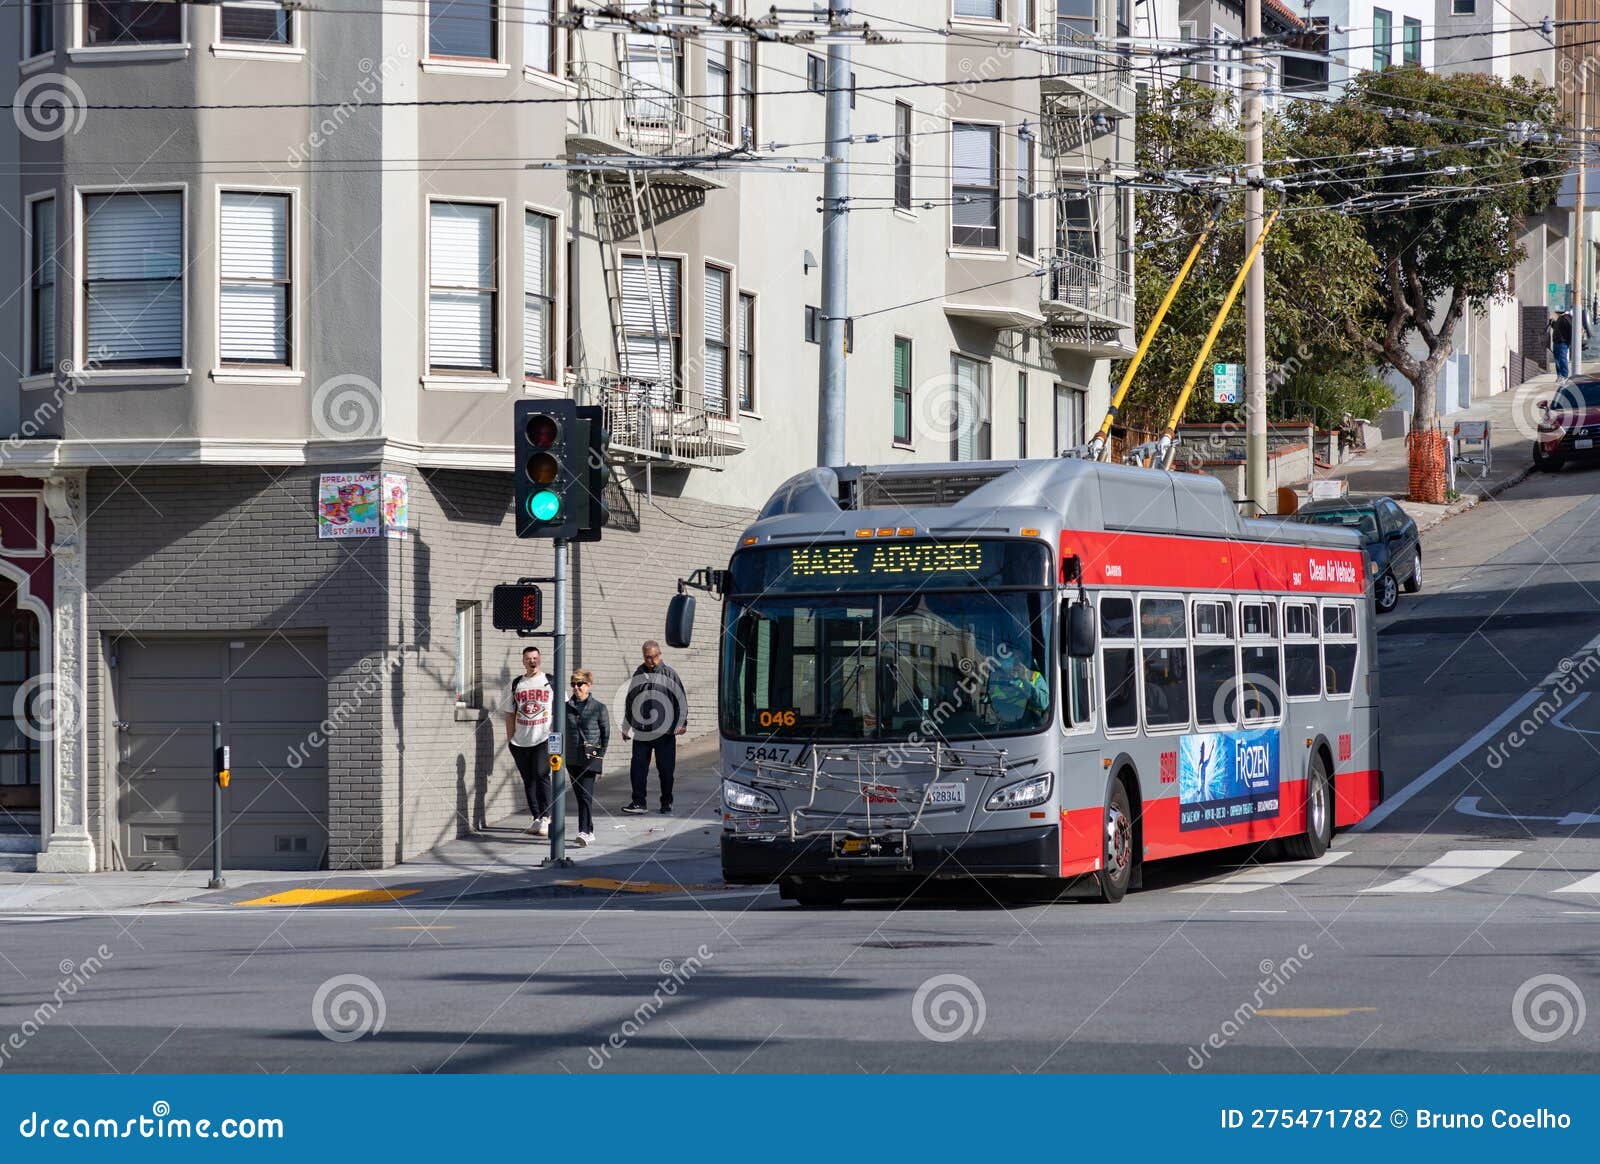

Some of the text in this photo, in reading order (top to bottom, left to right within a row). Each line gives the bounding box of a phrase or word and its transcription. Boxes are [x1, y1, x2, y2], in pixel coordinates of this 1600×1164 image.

[322, 475, 353, 483] SPREAD
[354, 474, 375, 482] LOVE
[1309, 558, 1356, 583] Clean Air Vehicle
[760, 711, 796, 727] 046
[745, 746, 790, 762] 5847
[1235, 739, 1269, 787] FROZEN
